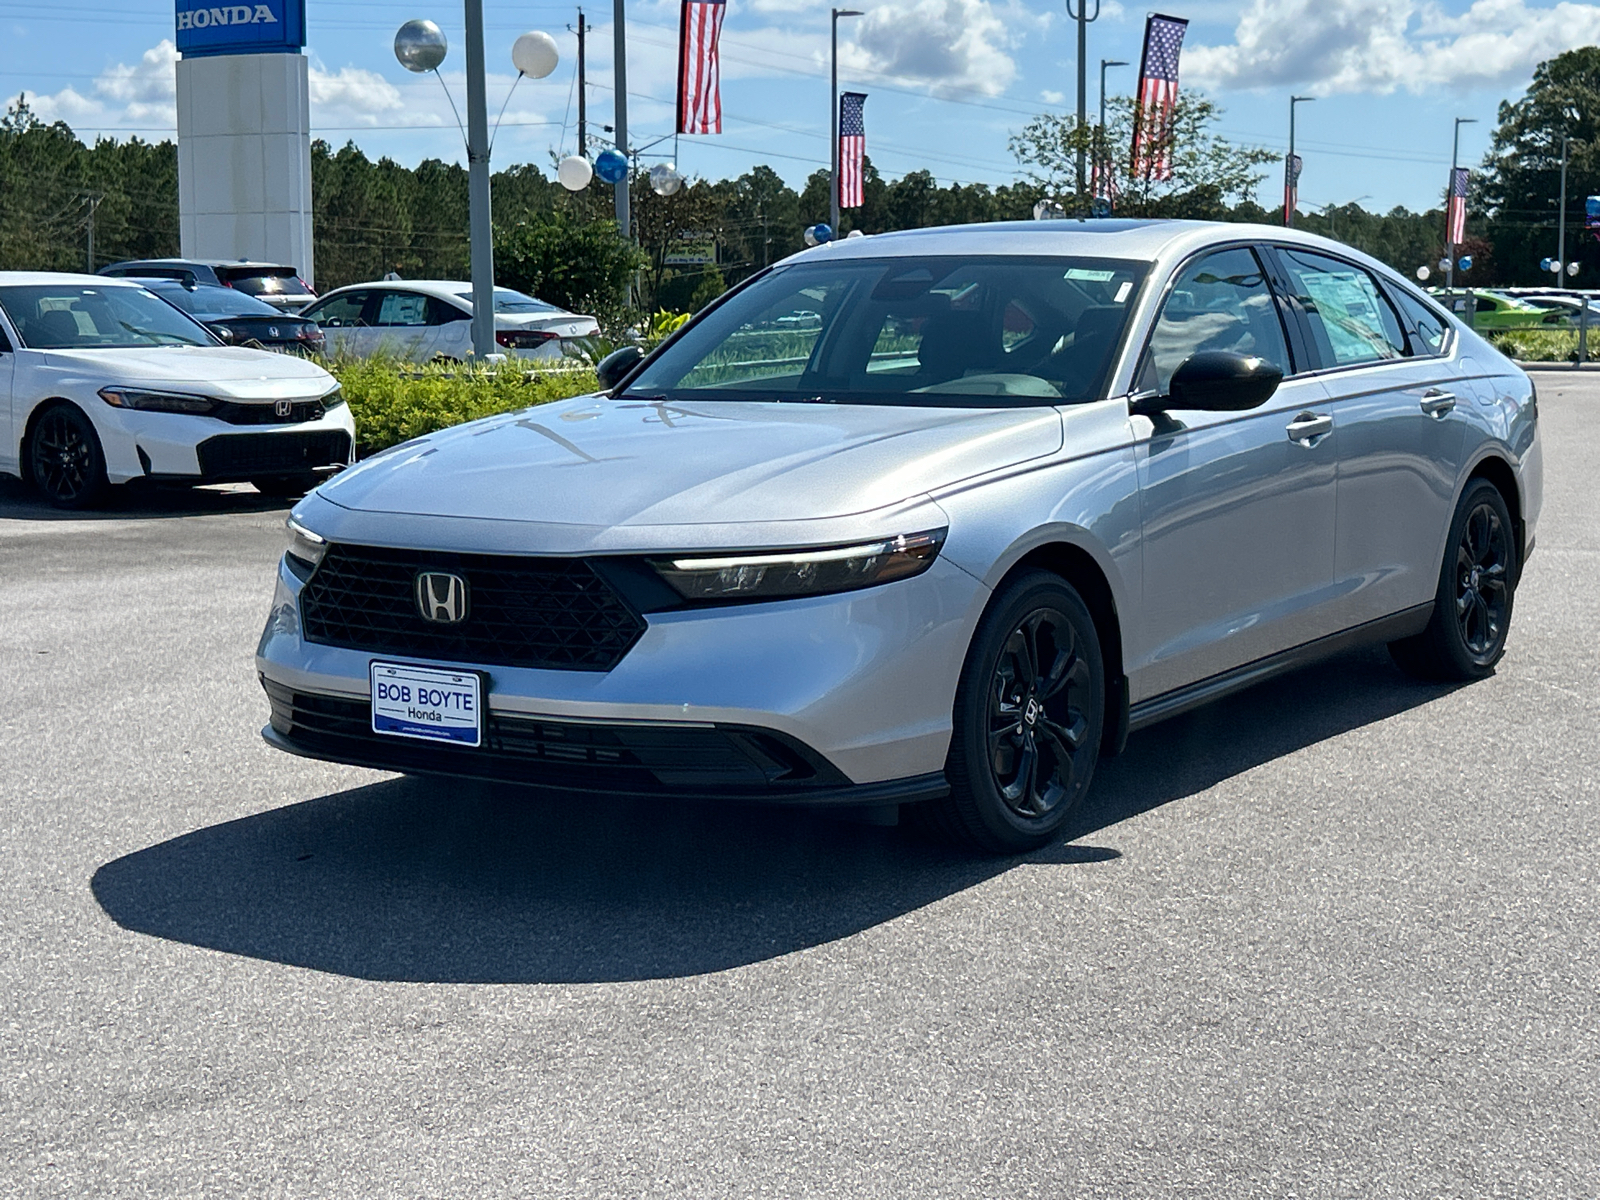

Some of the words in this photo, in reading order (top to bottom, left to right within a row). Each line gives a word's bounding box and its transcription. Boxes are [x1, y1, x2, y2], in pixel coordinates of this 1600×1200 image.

[177, 4, 278, 31] HONDA
[378, 682, 412, 703] BOB
[418, 688, 473, 711] BOYTE
[407, 707, 442, 722] Honda
